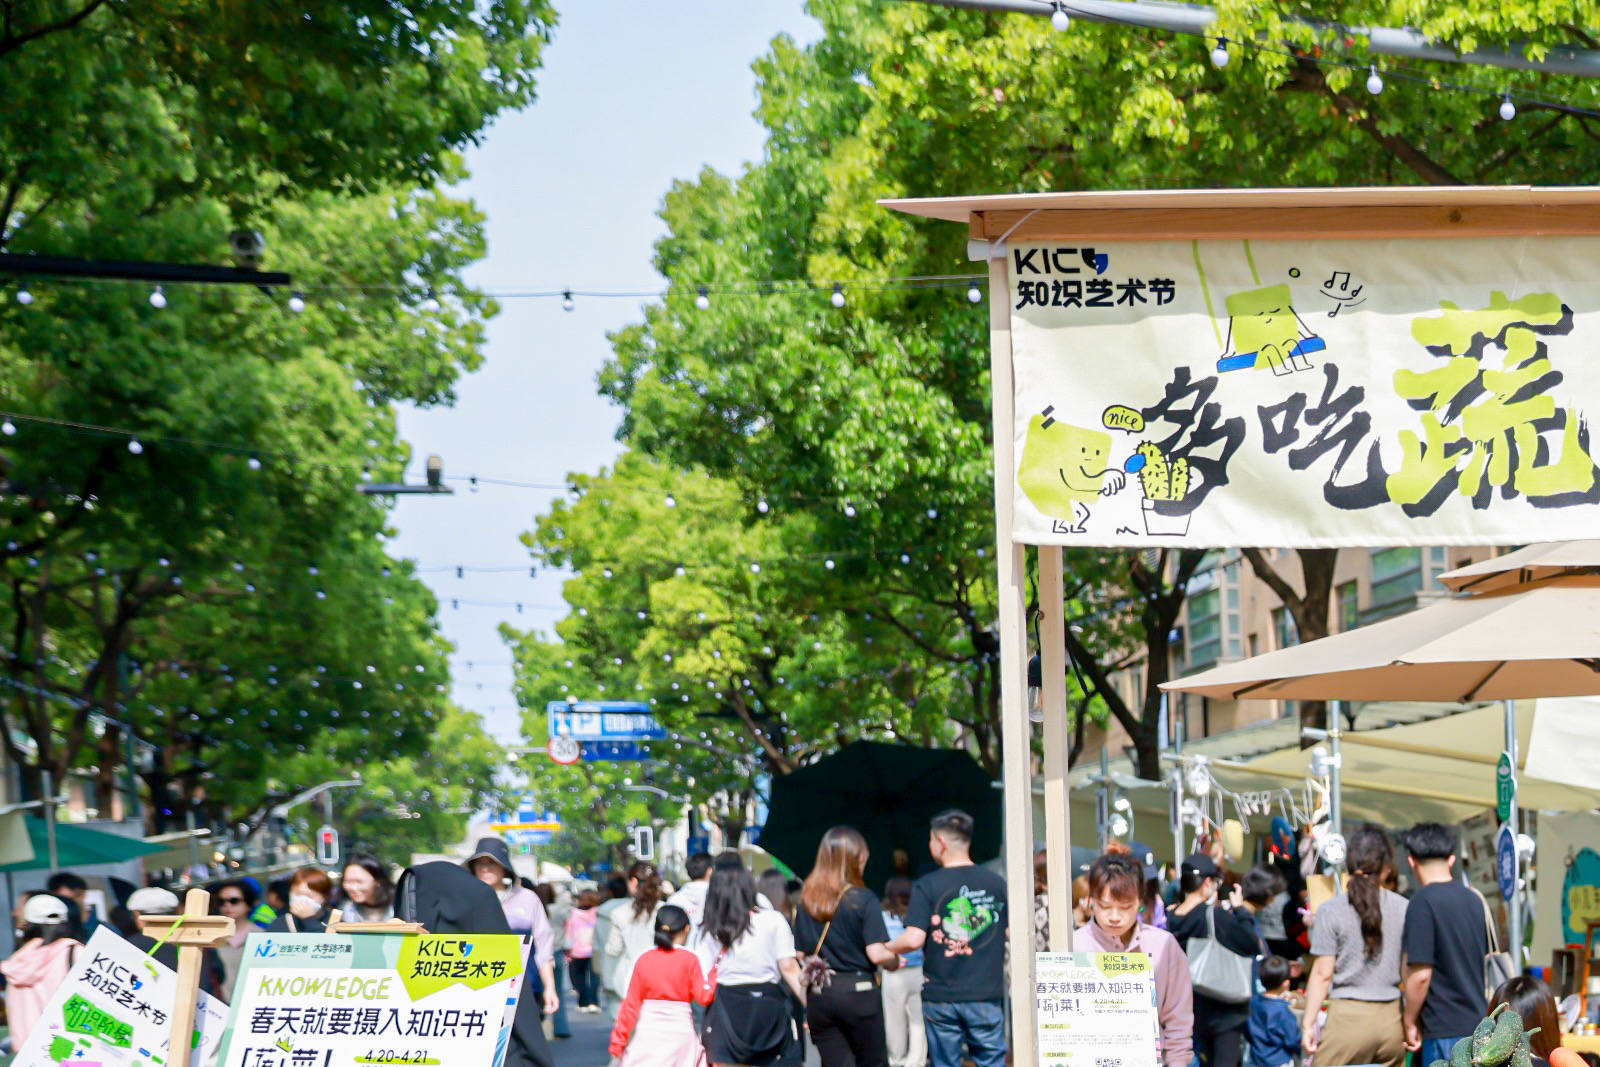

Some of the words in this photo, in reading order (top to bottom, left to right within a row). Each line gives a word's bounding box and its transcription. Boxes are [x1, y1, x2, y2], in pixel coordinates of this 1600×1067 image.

[1015, 279, 1176, 310] 知识艺术节
[1107, 410, 1139, 428] nice
[410, 960, 507, 979] 知识艺术节
[79, 968, 168, 1026] 知识艺术节
[257, 975, 393, 1000] KNOWLEDGE
[250, 1006, 488, 1038] 春天就要摄入知识书
